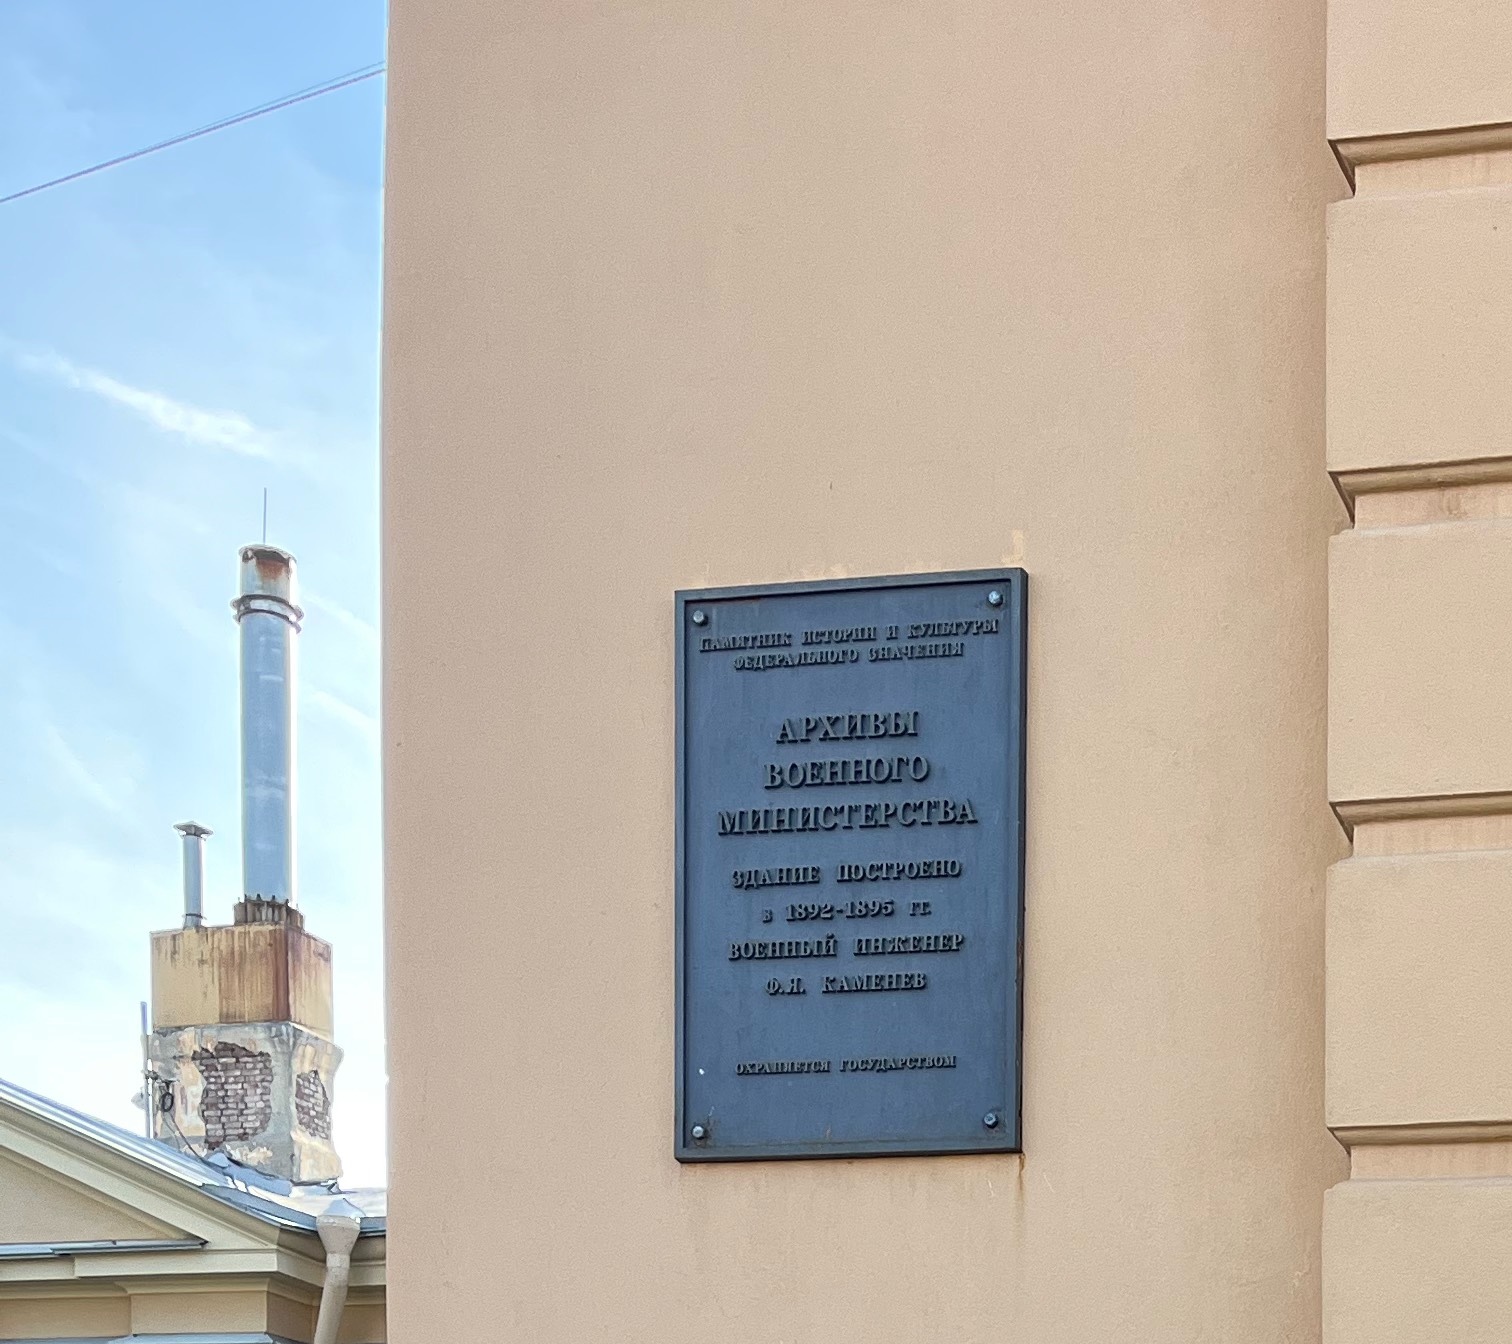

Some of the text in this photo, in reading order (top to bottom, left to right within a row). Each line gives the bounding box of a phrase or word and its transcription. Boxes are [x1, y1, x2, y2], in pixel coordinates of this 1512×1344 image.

[700, 619, 999, 652] ПАМЯТНИК ИСТОРИИ И КУЛЬТУРЫ
[733, 643, 964, 671] ФЕДЕРАЛЬНОГО ЗНАЧЕНИЯ
[776, 711, 918, 744] АРХИВЫ
[763, 756, 930, 789] ВОЕННОГО
[717, 798, 979, 836] МИНИСТЕРСТВА
[732, 860, 962, 889] ЗДАНИЕ ПОСТРОЕНО
[786, 900, 894, 921] 1892-1895
[728, 934, 964, 960] ВОЕННЫЙ ИНЖЕНЕР
[765, 973, 927, 995] Ф.Я. КАМЕНЕВ
[735, 1055, 957, 1075] ОХРАНЯЕТСЯ ГОСУДАРСТВОМ
